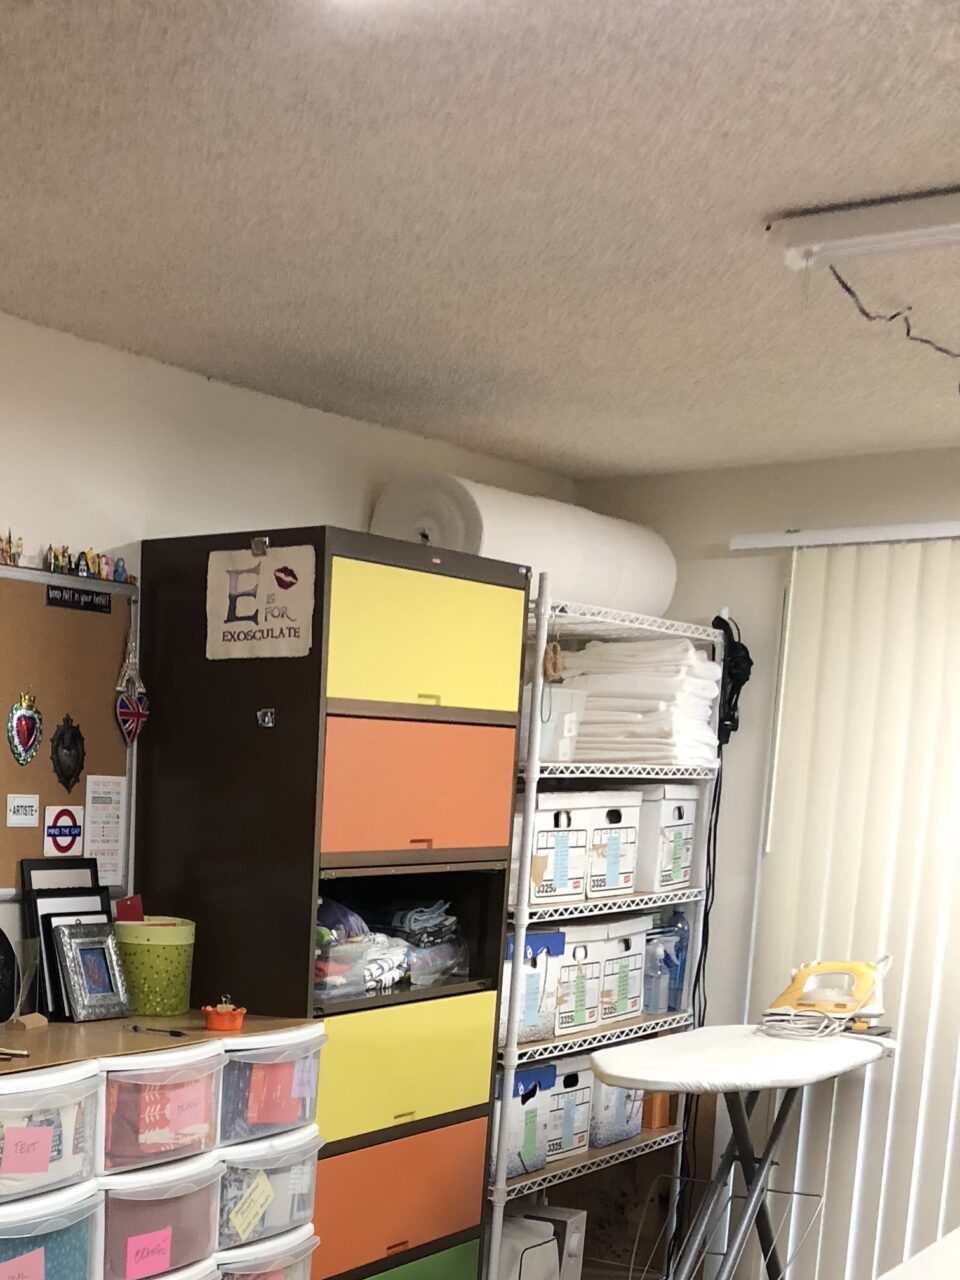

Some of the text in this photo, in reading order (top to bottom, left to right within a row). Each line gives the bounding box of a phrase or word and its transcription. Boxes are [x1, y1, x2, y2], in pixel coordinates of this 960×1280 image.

[224, 561, 261, 626] E
[266, 594, 275, 604] IS
[264, 606, 297, 622] FOR
[222, 626, 301, 642] EXOSCULATE
[12, 805, 35, 817] ARTISTE
[61, 827, 70, 835] THE
[71, 827, 81, 835] GAP
[547, 1141, 564, 1153] 3325
